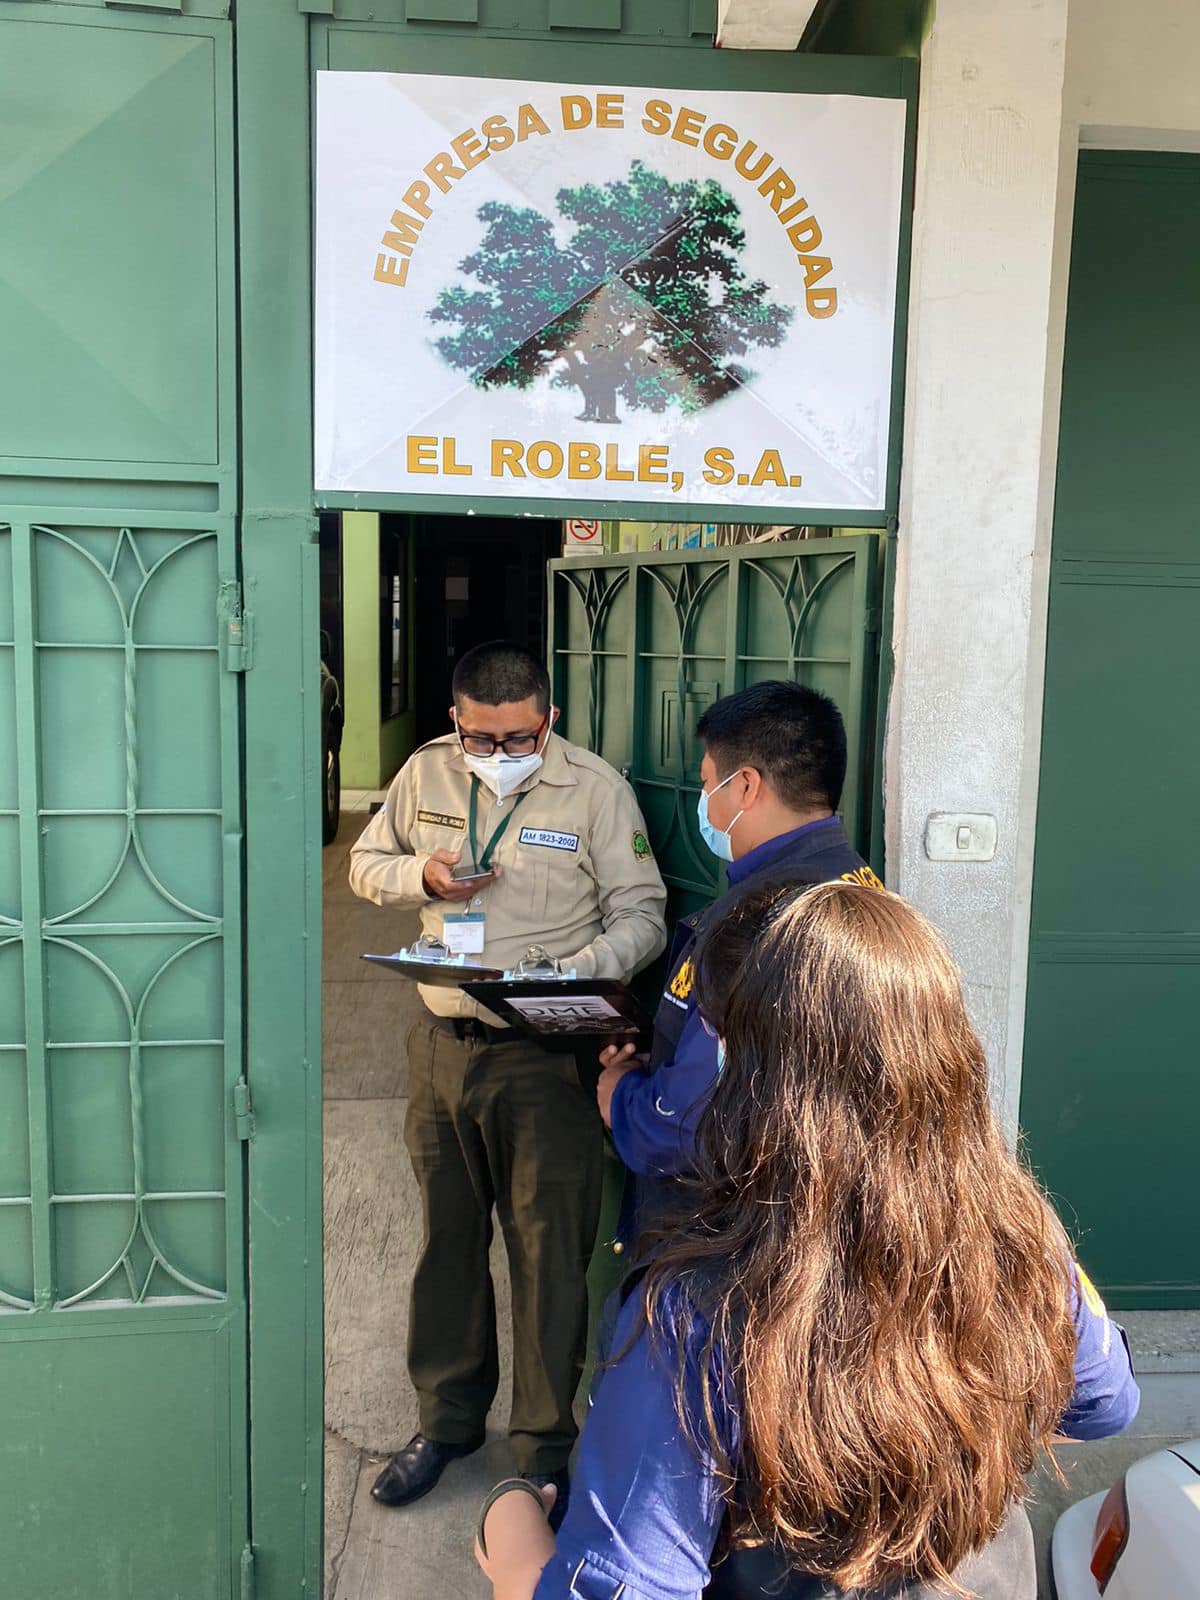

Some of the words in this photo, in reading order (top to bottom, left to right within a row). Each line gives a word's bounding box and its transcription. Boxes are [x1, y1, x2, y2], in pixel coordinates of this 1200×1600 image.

[373, 103, 550, 288] EMPRESA
[561, 93, 625, 131] DE
[642, 98, 839, 321] SEGURIDAD
[406, 435, 473, 476] EL
[490, 438, 684, 492] ROBLE,
[702, 446, 804, 488] S.A.
[522, 832, 537, 841] AM
